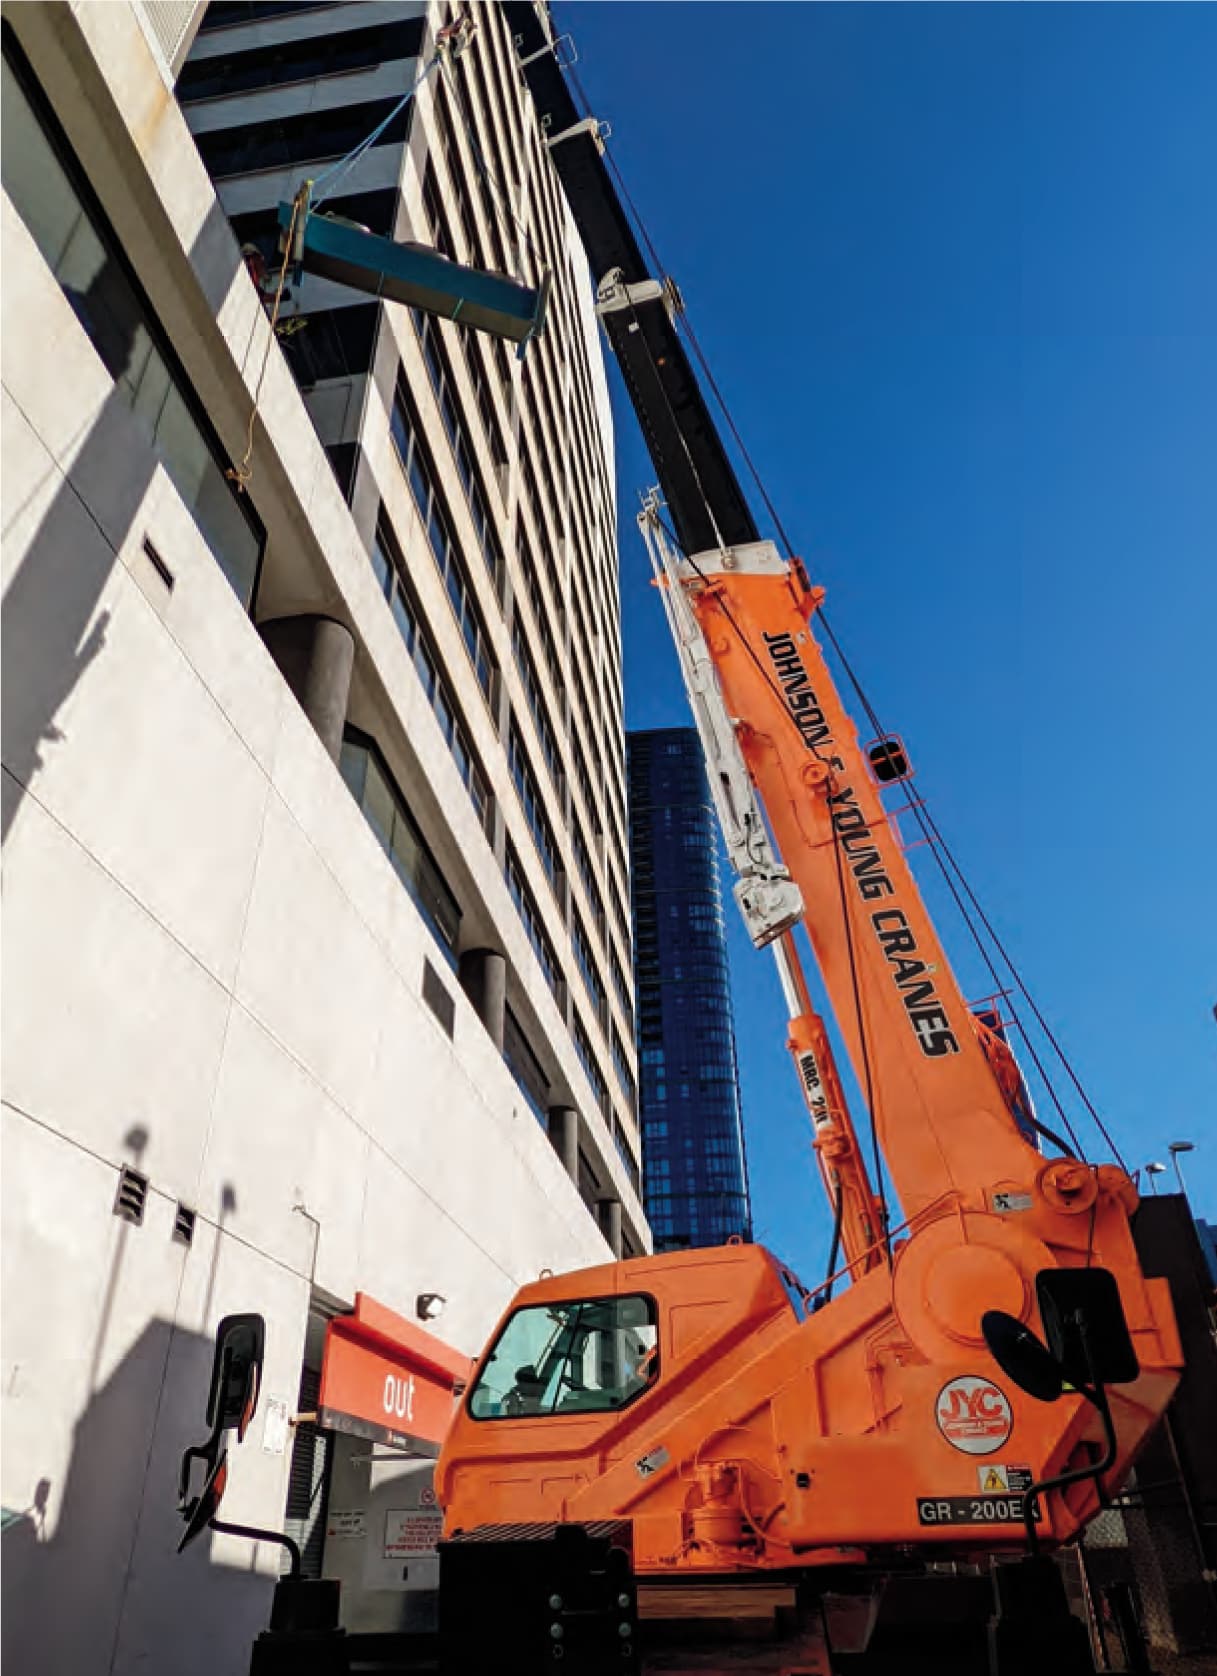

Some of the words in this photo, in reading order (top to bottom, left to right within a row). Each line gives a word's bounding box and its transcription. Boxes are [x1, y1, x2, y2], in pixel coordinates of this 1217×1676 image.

[762, 631, 834, 750] JOHNSON
[826, 787, 894, 901] YOUNG
[870, 908, 959, 1057] CRANES
[383, 1373, 415, 1421] out
[940, 1387, 1002, 1419] JYC
[920, 1502, 952, 1521] GR
